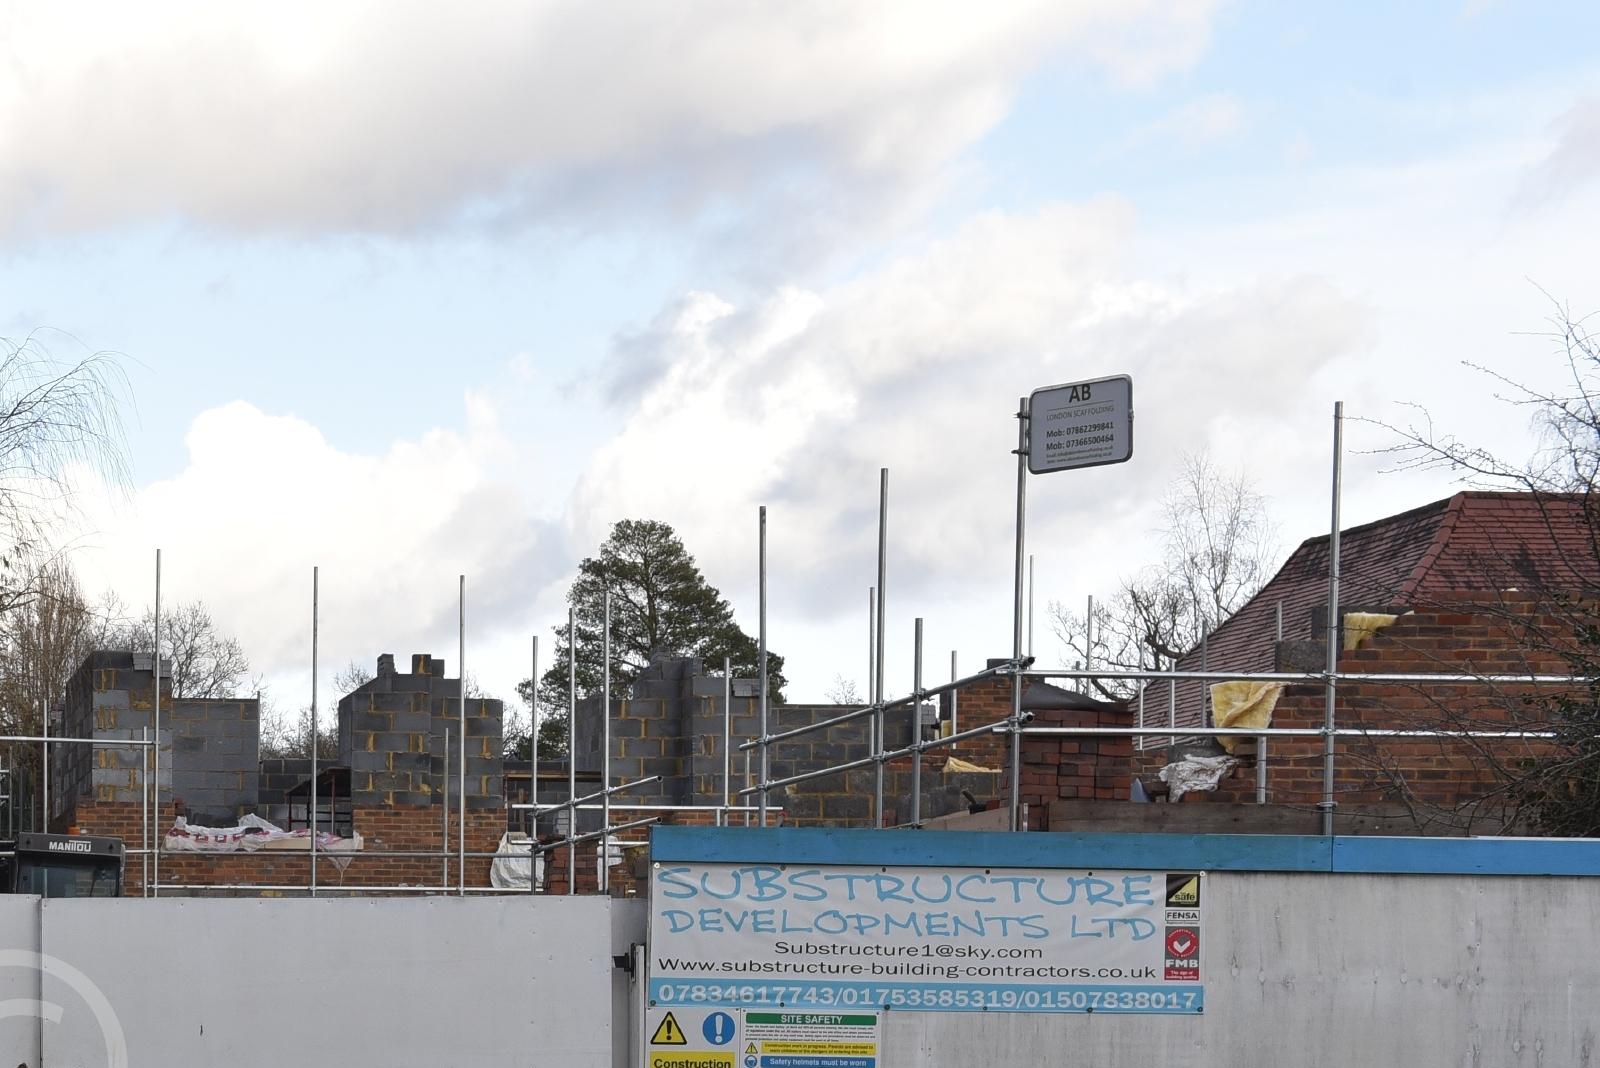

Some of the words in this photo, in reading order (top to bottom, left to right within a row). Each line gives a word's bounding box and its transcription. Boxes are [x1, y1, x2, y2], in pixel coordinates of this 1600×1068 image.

[1068, 384, 1092, 403] AB
[1046, 428, 1065, 438] Mob:
[1046, 441, 1065, 450] Mob:
[49, 840, 92, 852] MANITOU
[657, 866, 1155, 908] SUBSTRUCTURE
[1174, 892, 1196, 901] safe
[1166, 911, 1198, 919] FENSA
[660, 907, 1050, 939] DEVELOPMENTS
[1071, 915, 1156, 941] LTD
[774, 941, 1043, 960] Substructure1@sky.com
[658, 958, 1157, 978] Www.substructure-building-contractors.co.uk
[1165, 959, 1199, 968] FMB
[658, 984, 1197, 1009] 07834617743/01753585319/01507838017
[780, 1014, 801, 1024] SITE
[805, 1015, 843, 1024] SAFETY
[769, 1058, 791, 1066] Safety
[793, 1058, 820, 1066] helmets
